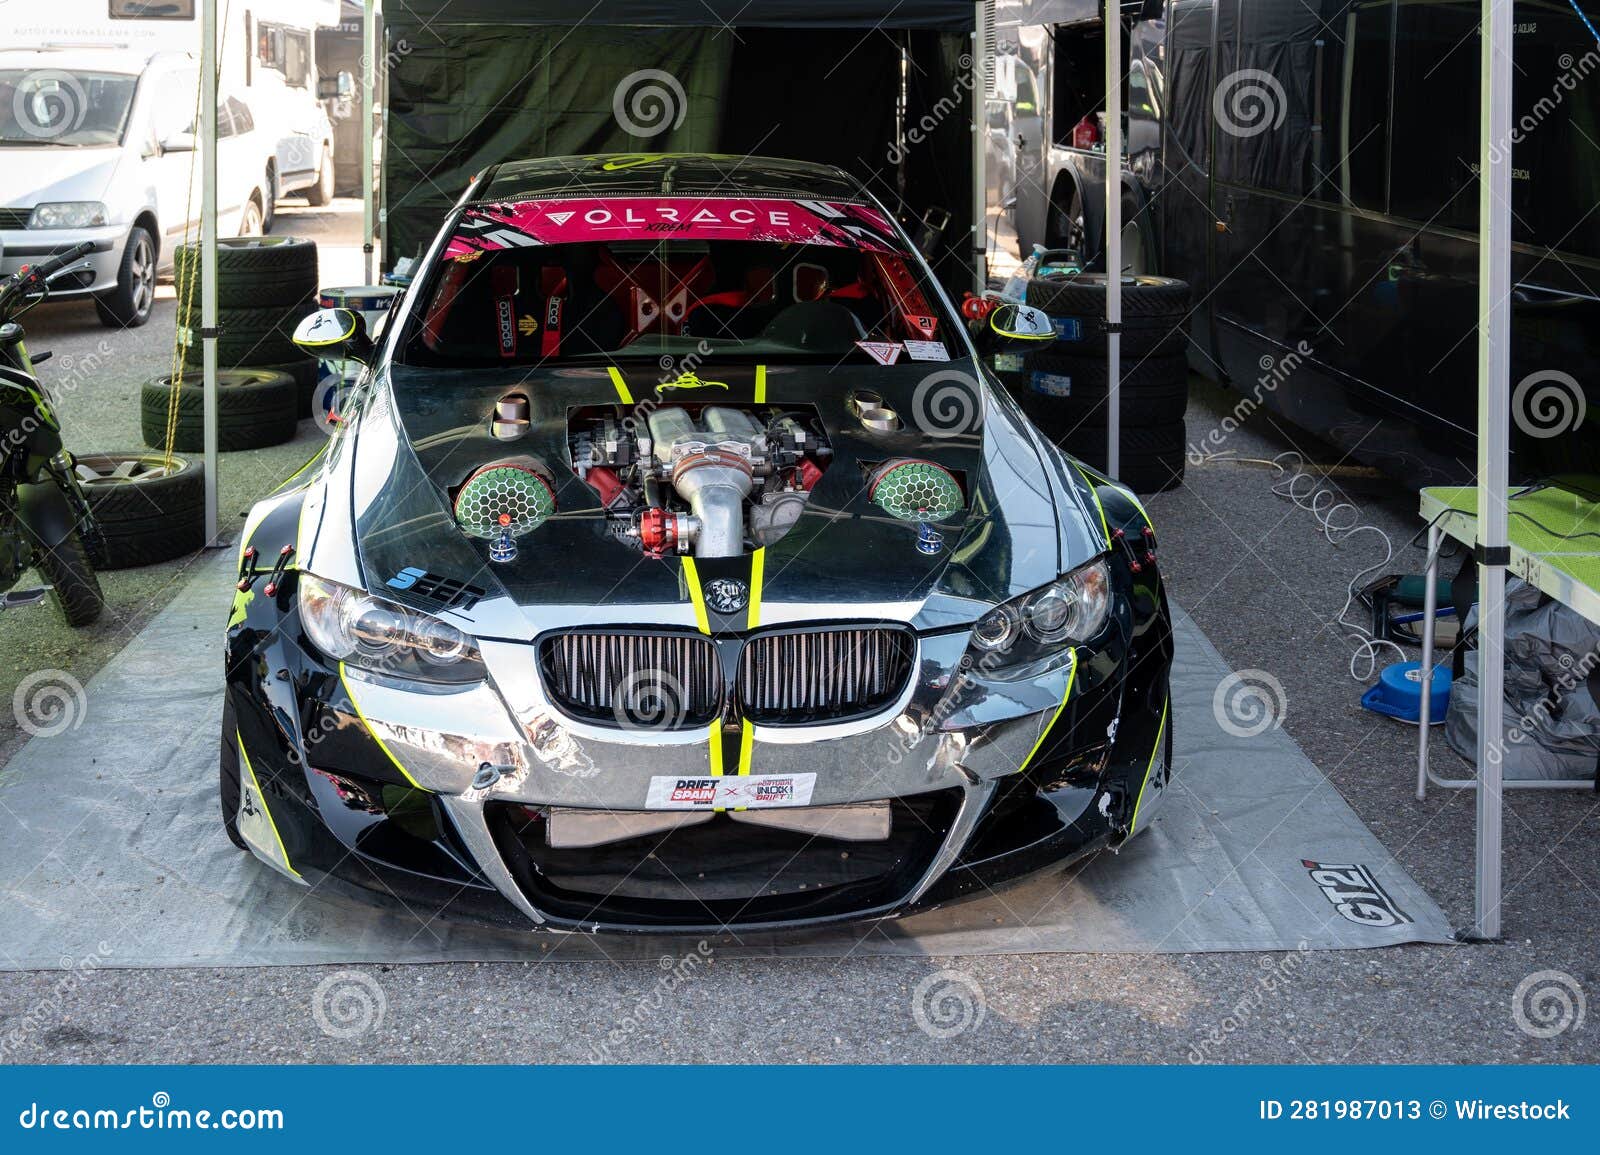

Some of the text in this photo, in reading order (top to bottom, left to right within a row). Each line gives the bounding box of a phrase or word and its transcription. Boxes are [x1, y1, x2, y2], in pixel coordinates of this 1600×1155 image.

[548, 296, 561, 324] arco
[675, 780, 720, 789] DRIFT
[673, 790, 715, 800] SPAIN
